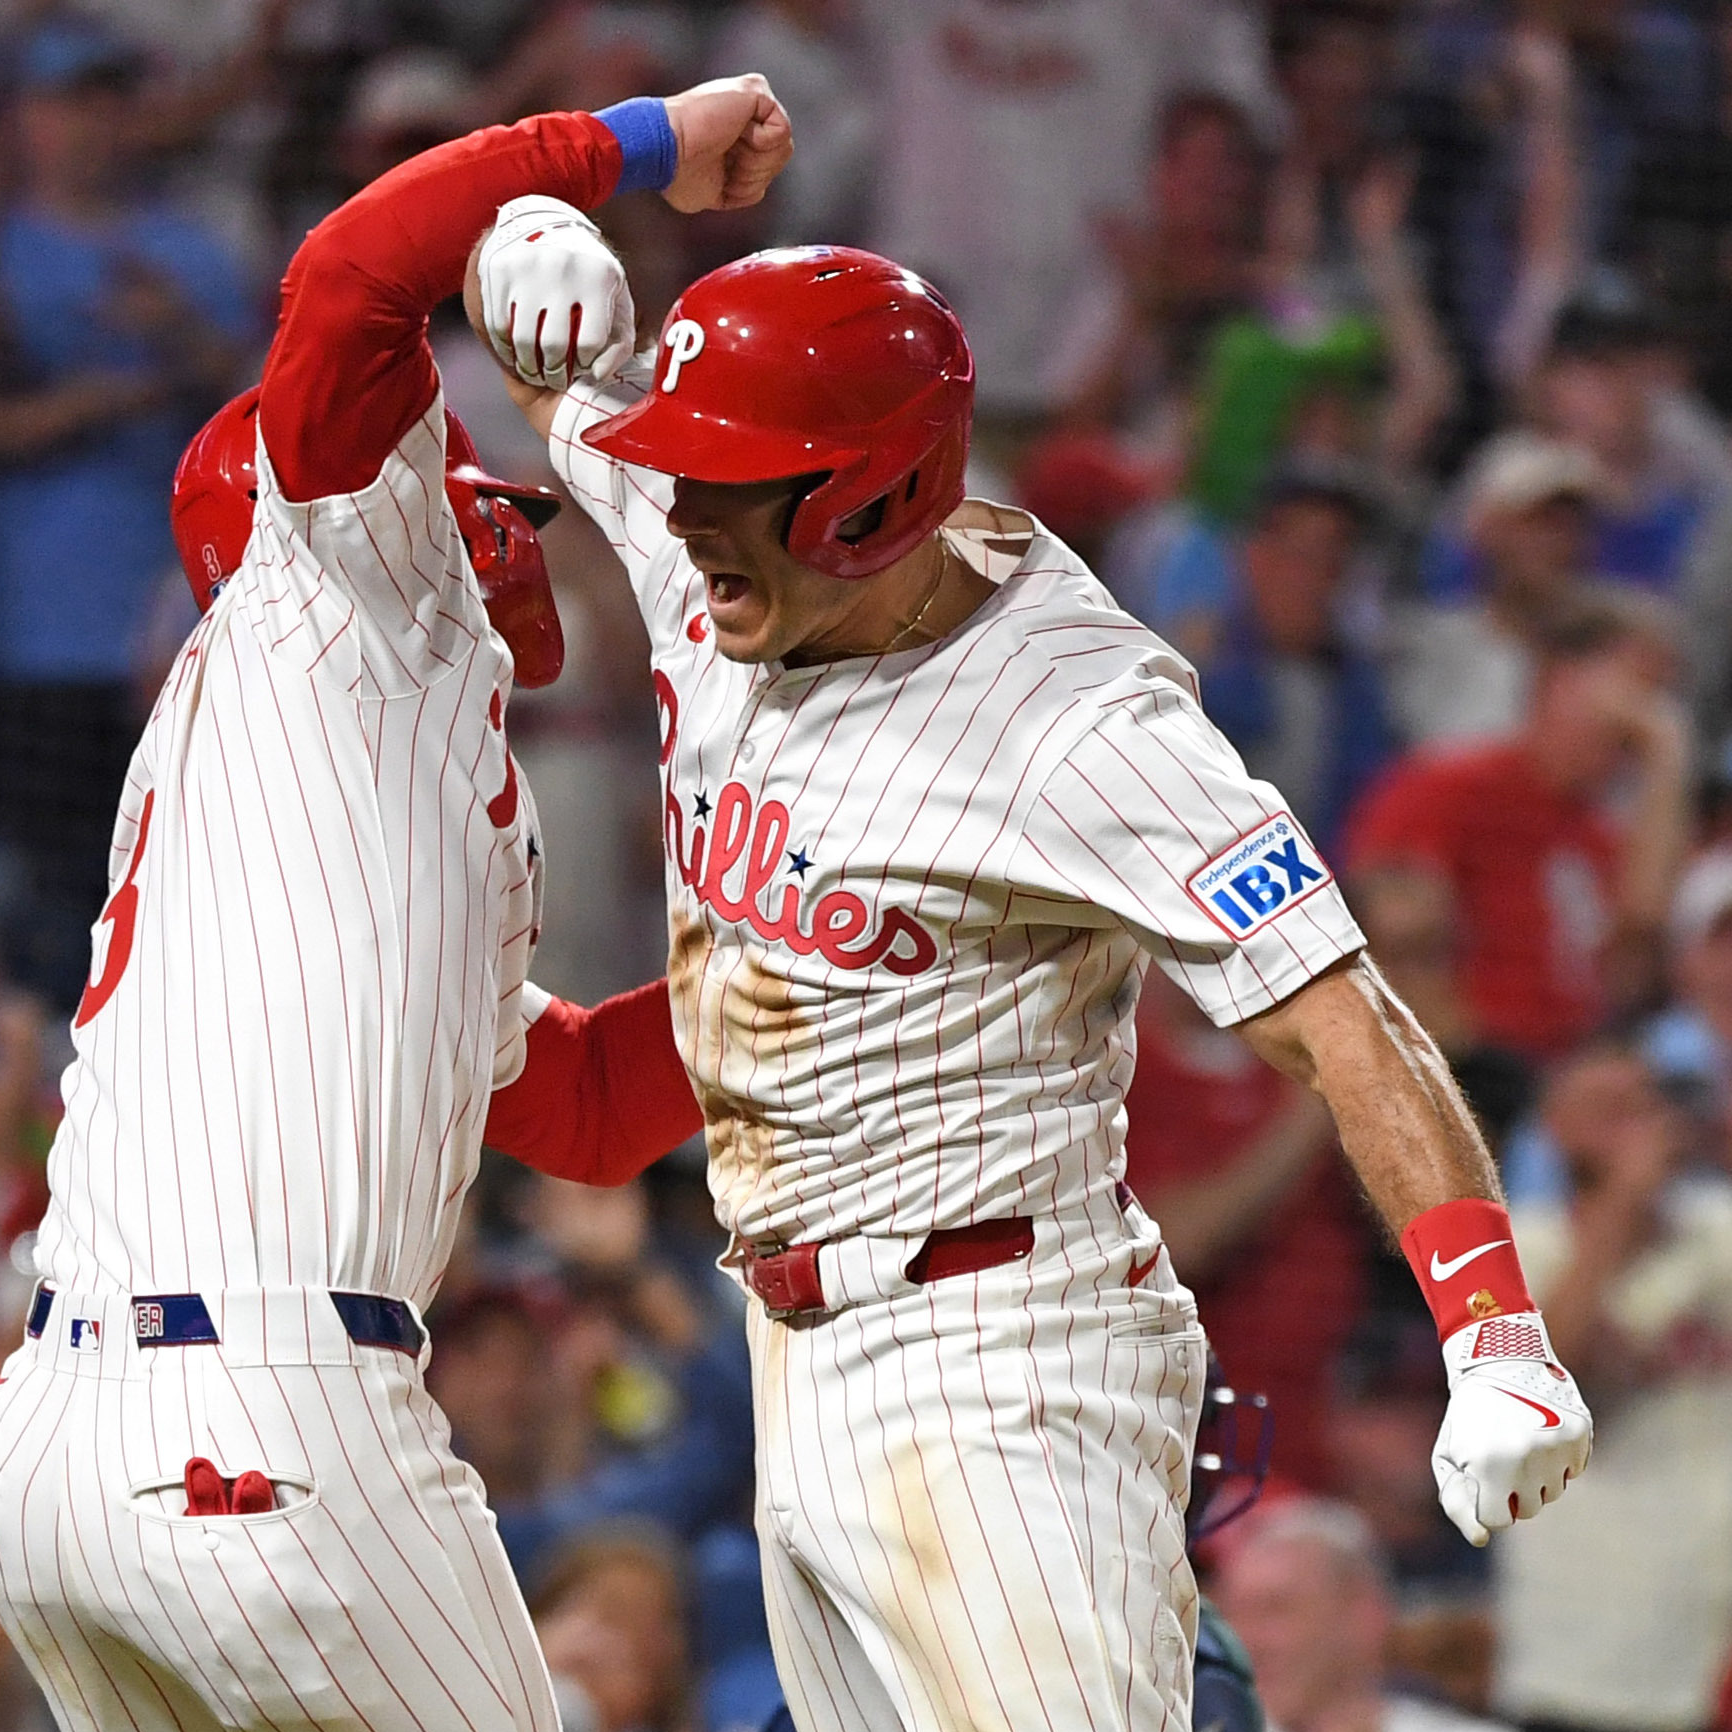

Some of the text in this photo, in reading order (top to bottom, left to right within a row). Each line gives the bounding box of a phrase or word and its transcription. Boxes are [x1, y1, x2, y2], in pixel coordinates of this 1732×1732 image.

[661, 319, 705, 393] P
[202, 544, 222, 582] 3
[1196, 830, 1276, 891] Independence
[1209, 836, 1324, 931] IBX
